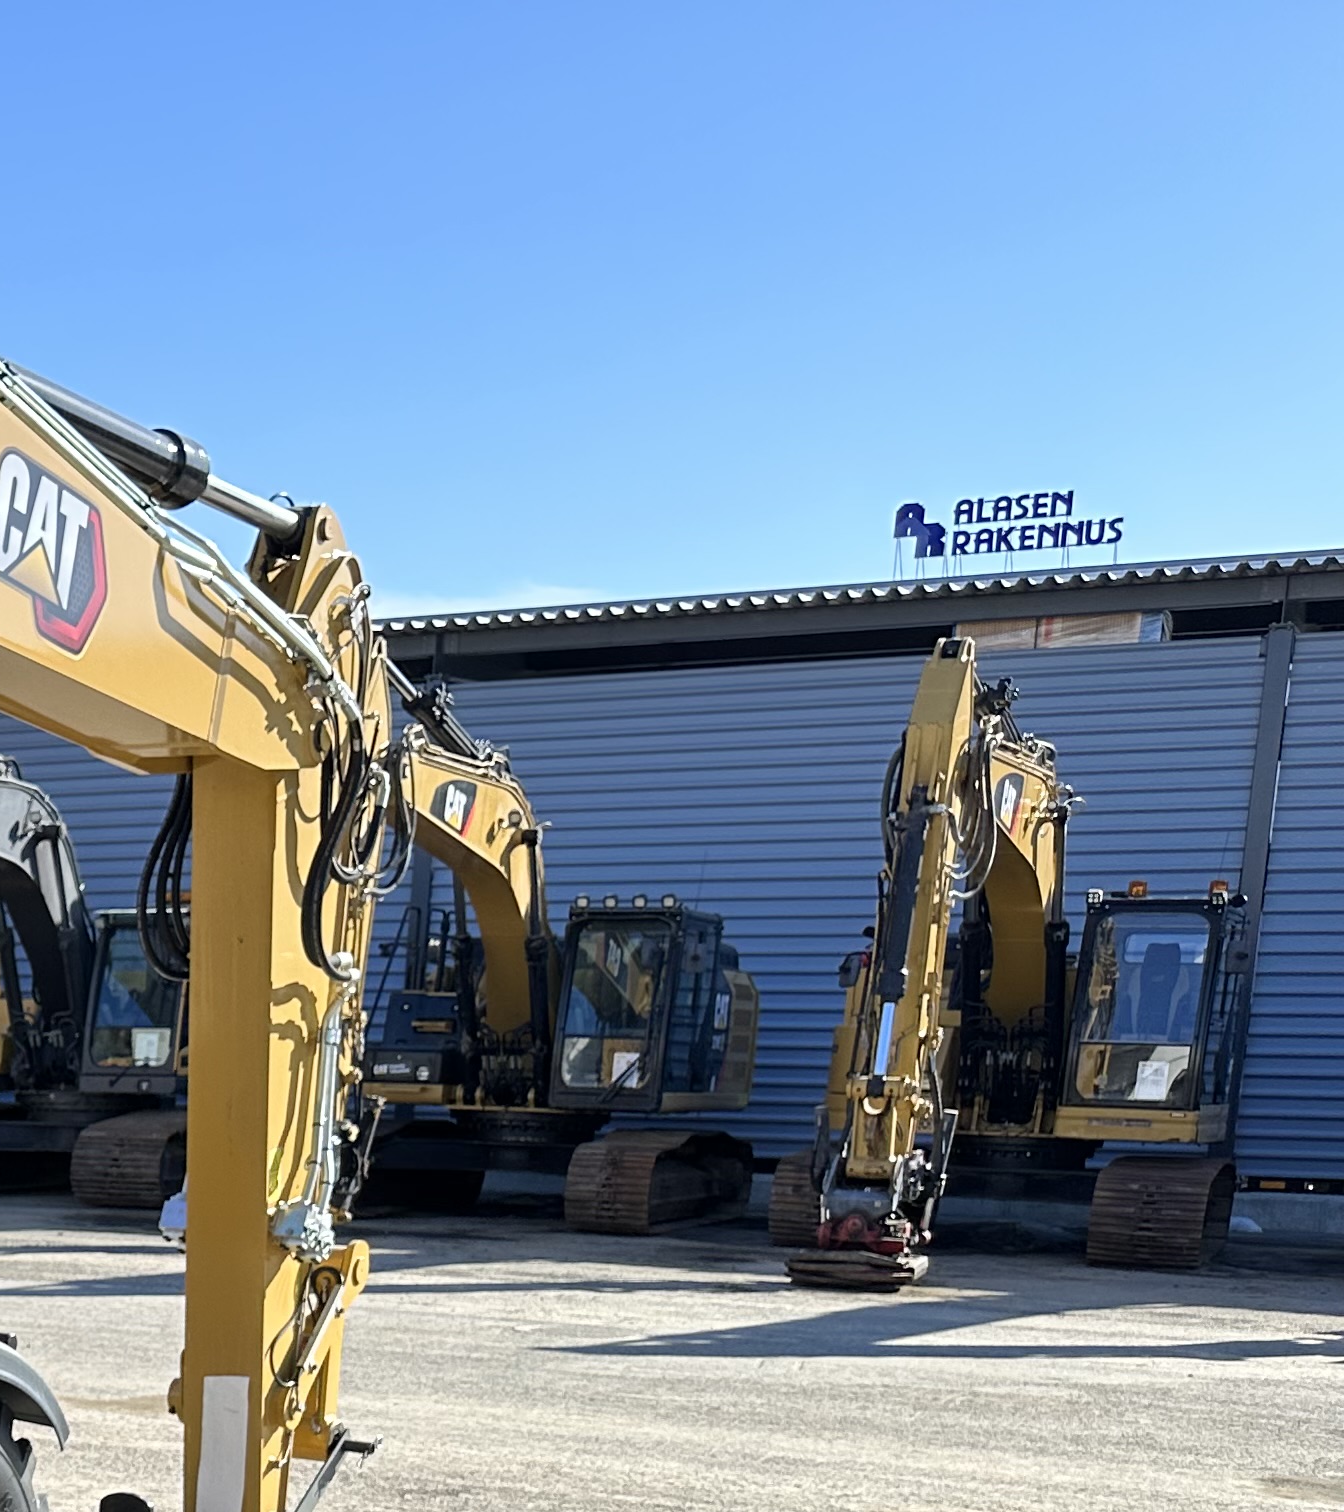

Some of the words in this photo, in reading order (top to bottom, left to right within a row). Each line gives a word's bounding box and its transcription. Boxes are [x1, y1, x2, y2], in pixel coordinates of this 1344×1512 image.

[954, 490, 1074, 525] ALASEN
[951, 517, 1124, 556] RAKENNUS
[443, 783, 468, 832] CAT
